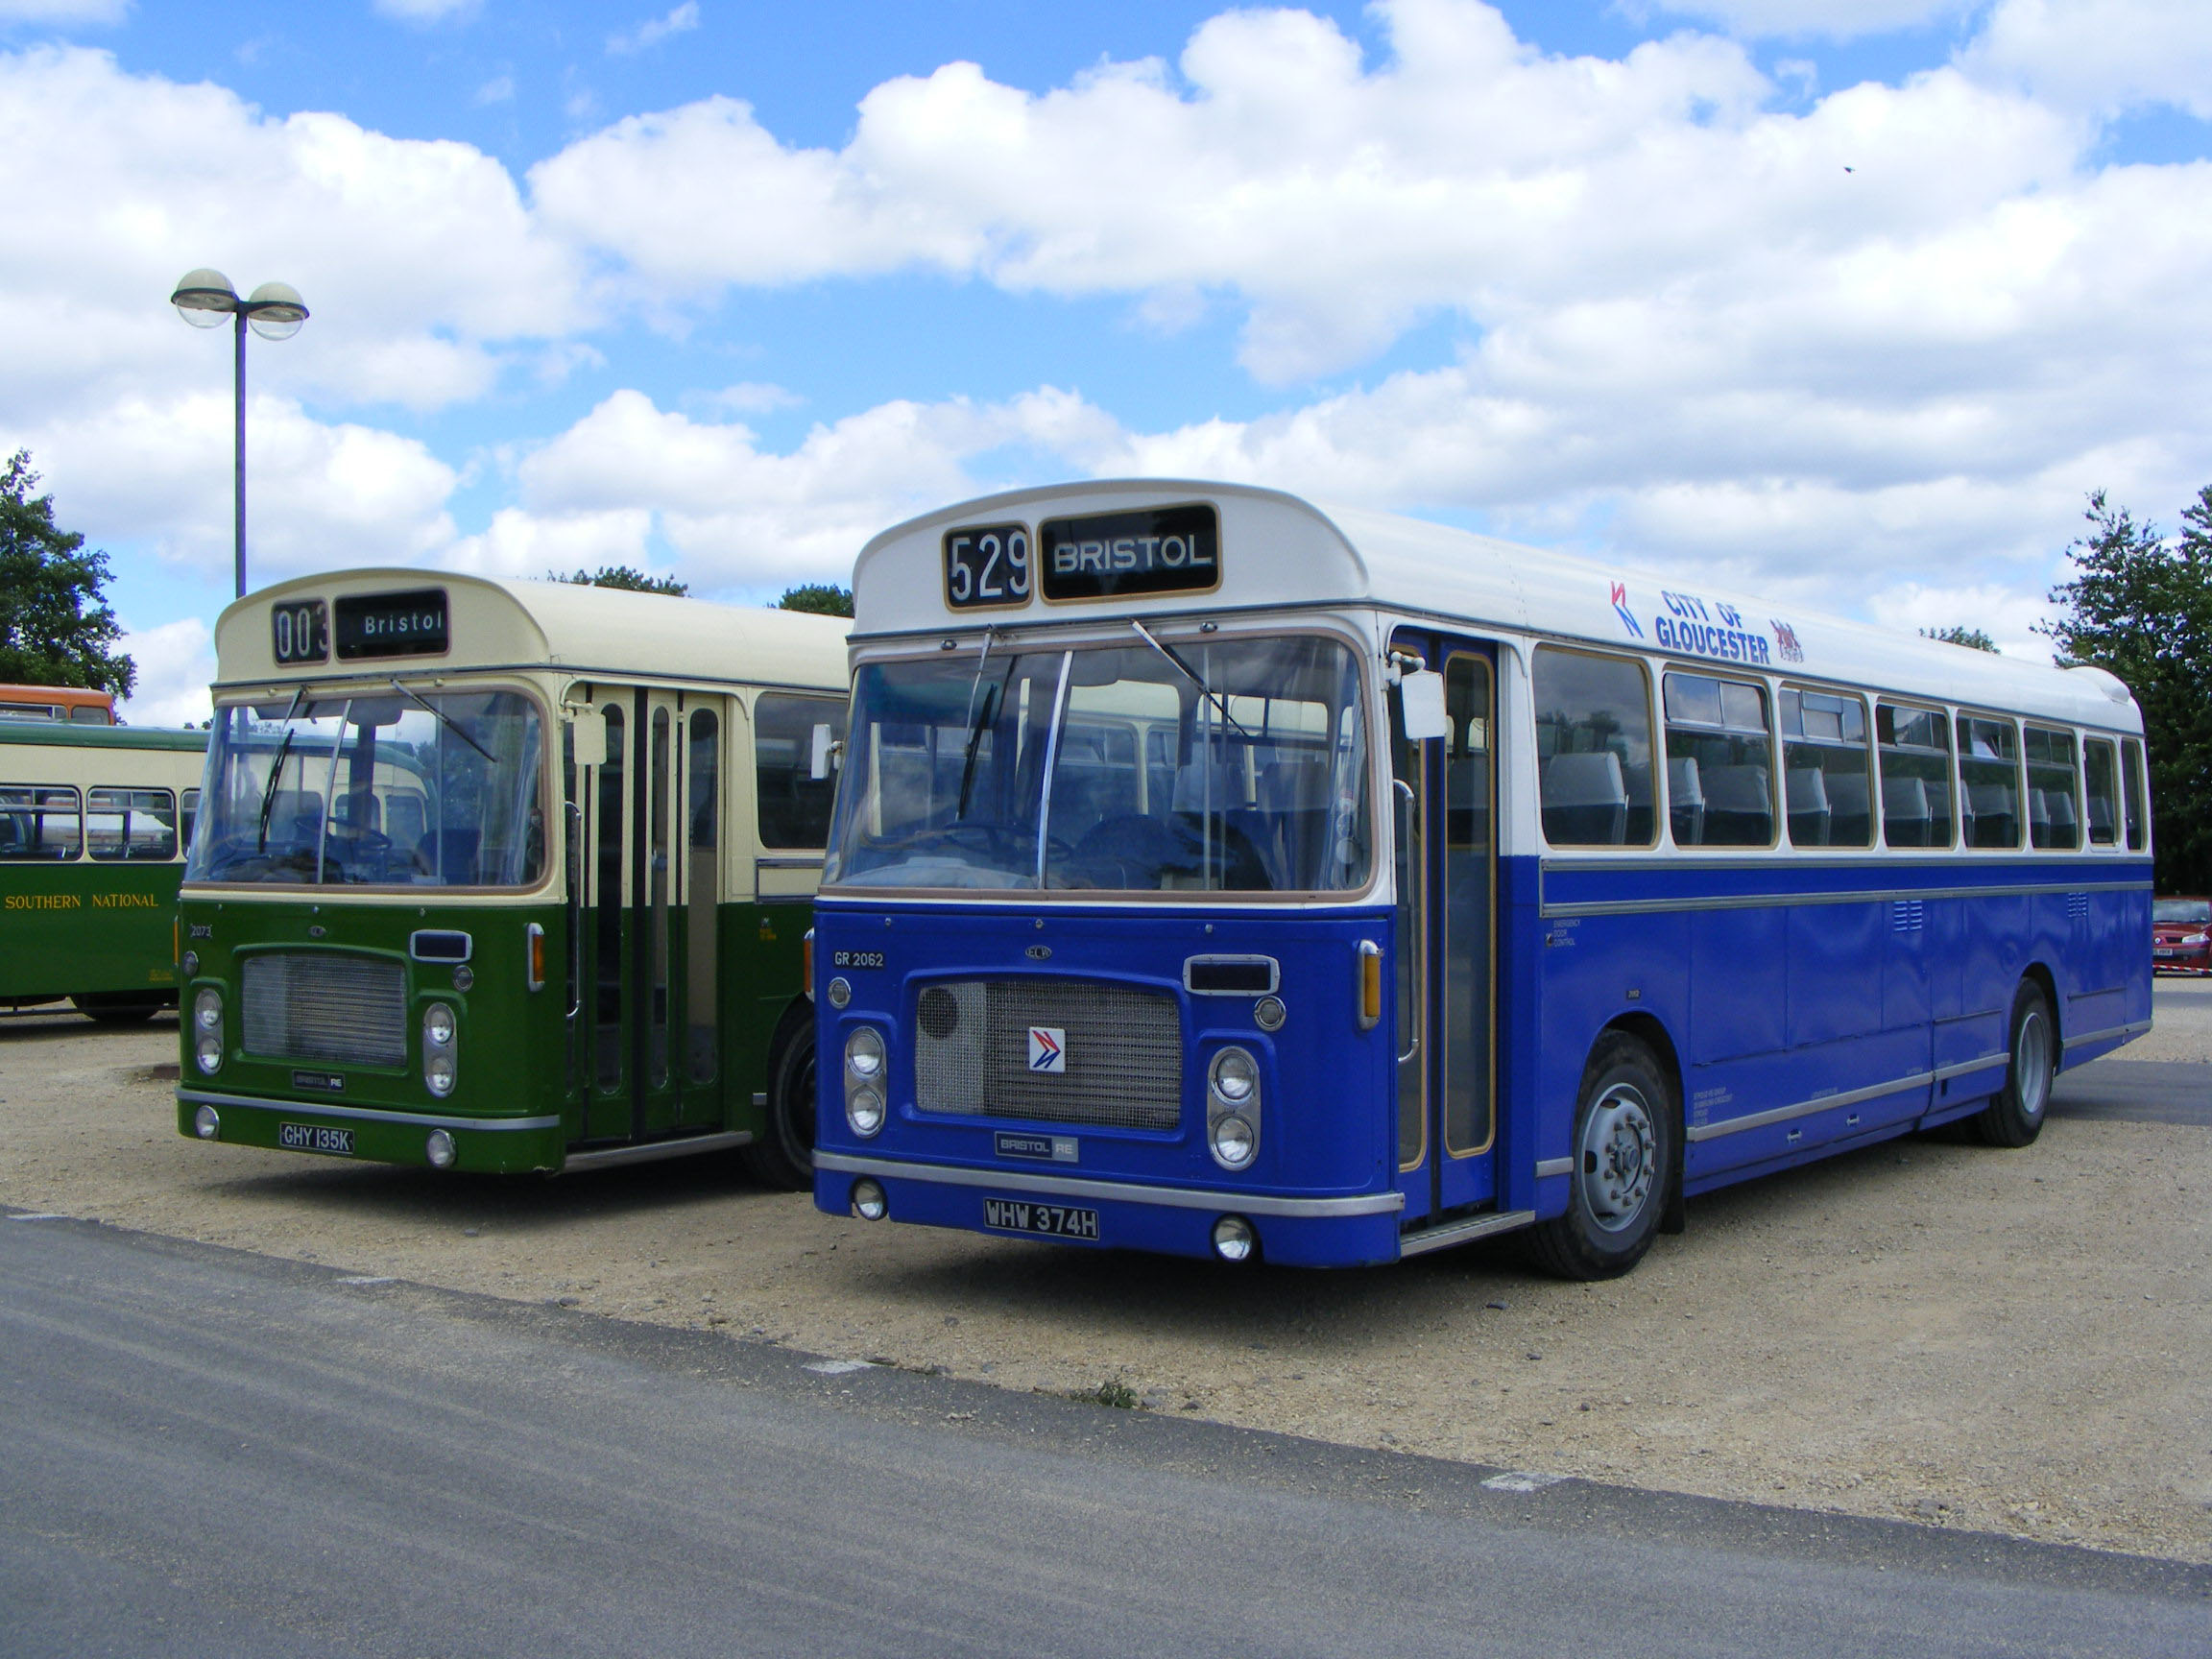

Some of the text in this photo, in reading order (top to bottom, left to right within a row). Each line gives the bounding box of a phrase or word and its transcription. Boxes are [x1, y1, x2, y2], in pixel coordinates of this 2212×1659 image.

[951, 530, 1030, 601] 529
[1055, 534, 1213, 573] BRISTOL
[1661, 590, 1743, 628] CITY OF
[365, 610, 442, 635] Bristol
[1655, 615, 1770, 664] GLOUCESTER
[5, 894, 159, 909] SOUTHERN NATIONAL
[192, 926, 211, 937] 2073
[834, 951, 883, 967] GR 2062
[284, 1125, 349, 1150] GHY 135K
[1000, 1139, 1073, 1155] BRISTOL RE
[986, 1200, 1097, 1236] WHW 374H
